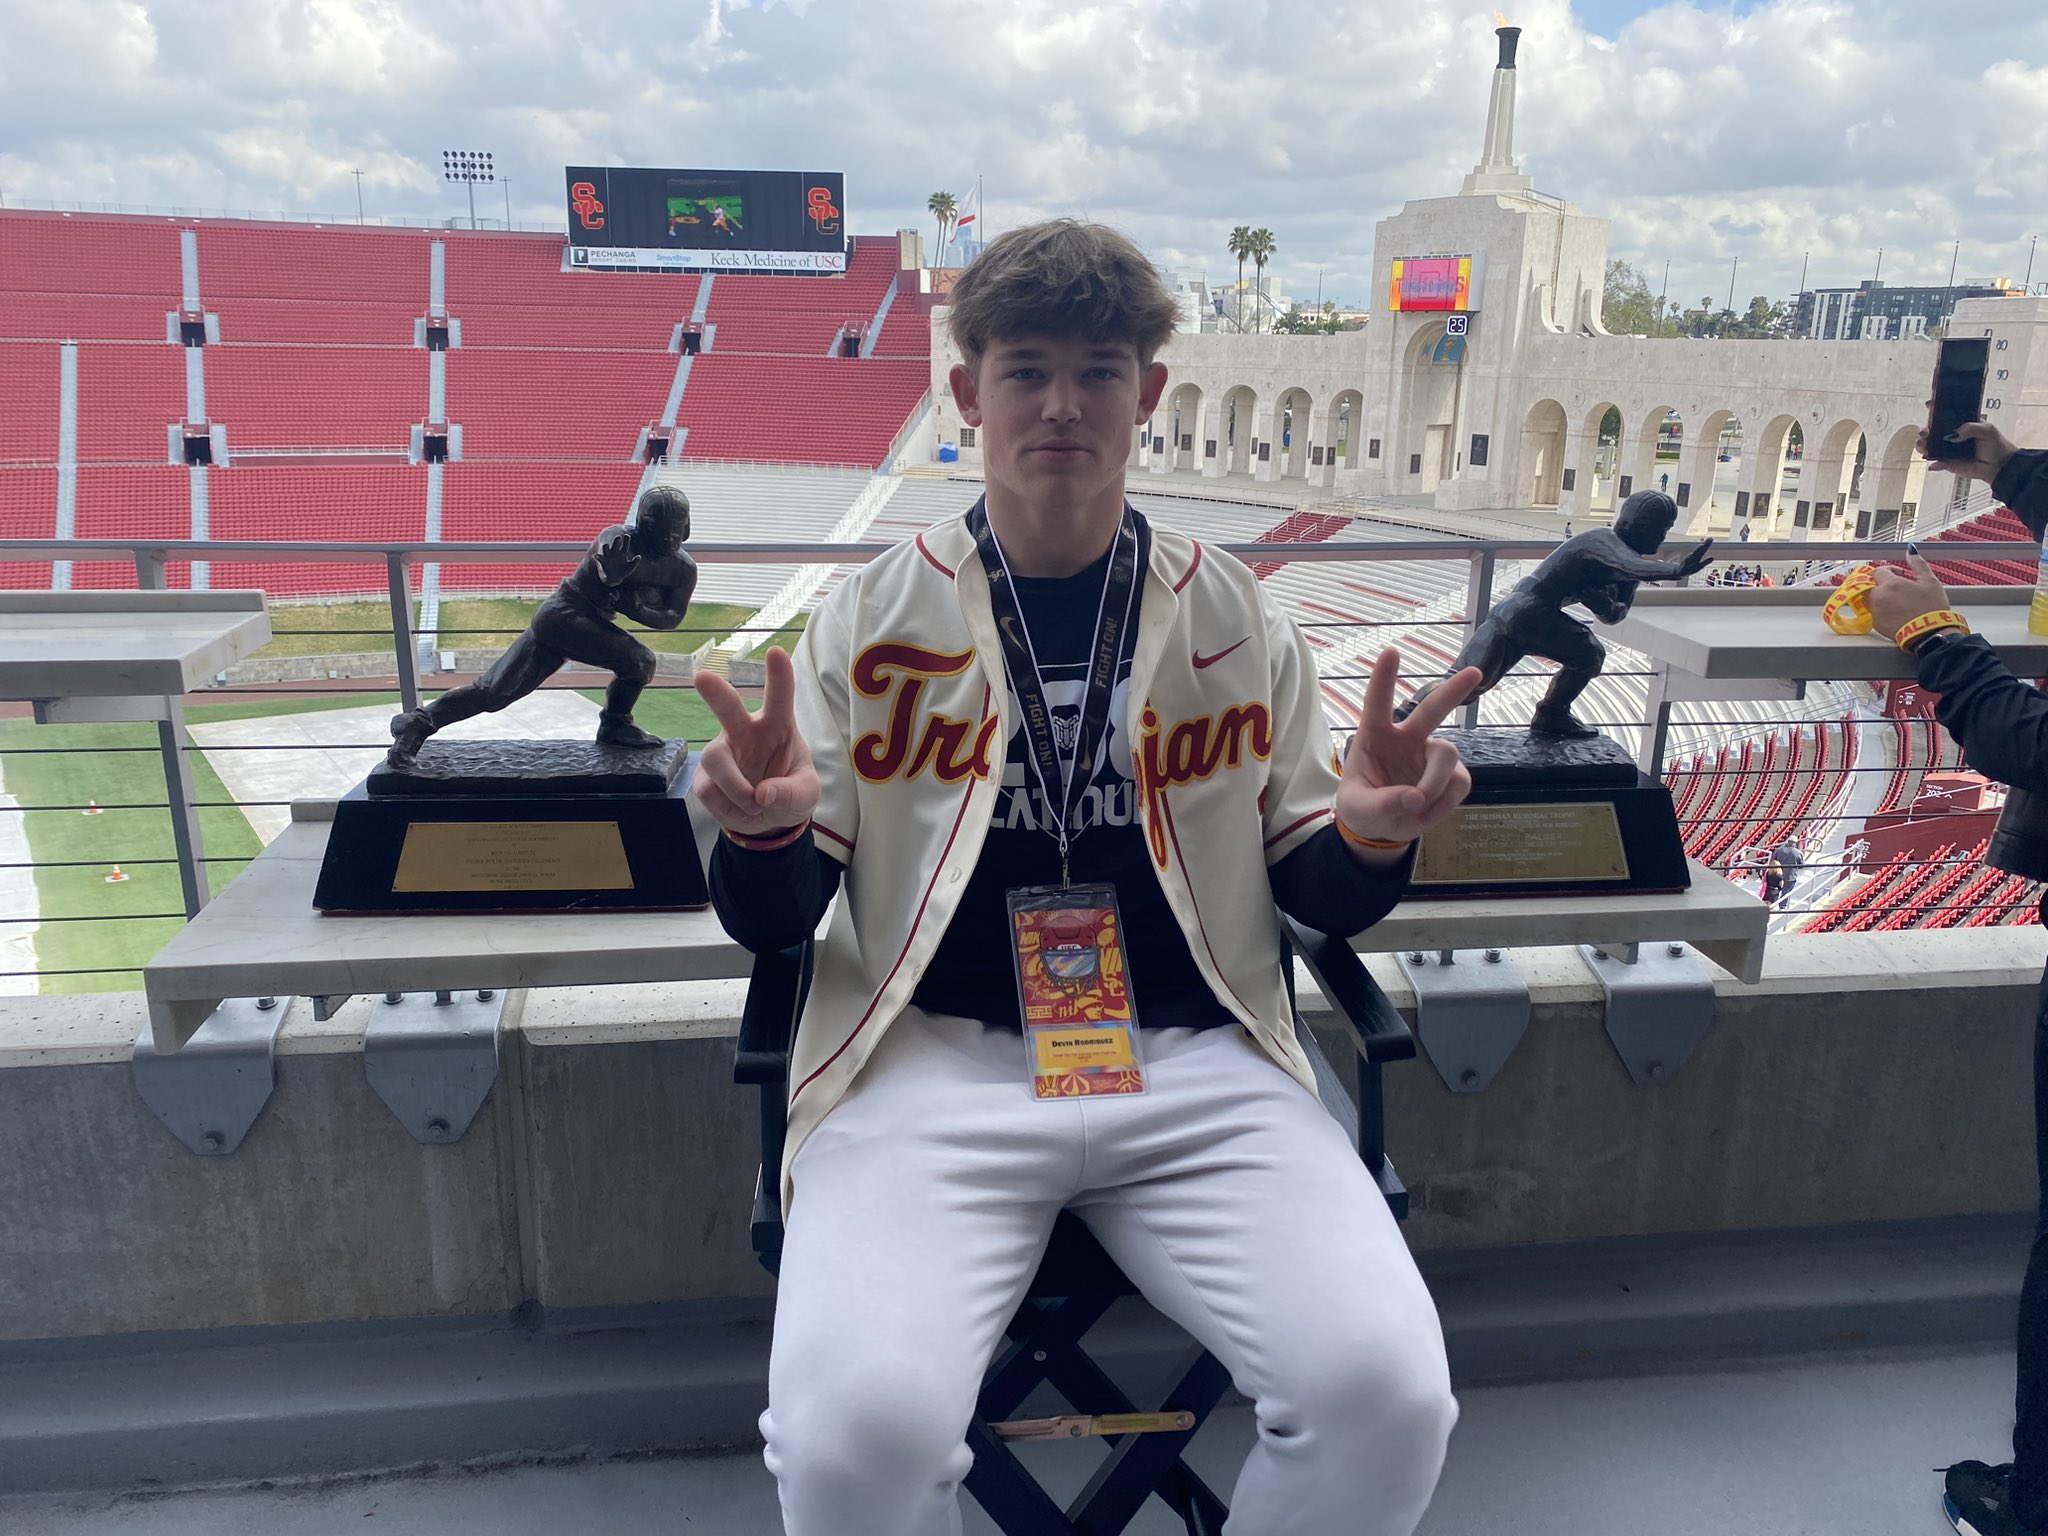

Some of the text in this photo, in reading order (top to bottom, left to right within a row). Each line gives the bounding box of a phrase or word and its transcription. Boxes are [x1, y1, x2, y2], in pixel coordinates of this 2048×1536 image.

[590, 250, 636, 258] PECHANGA
[656, 254, 692, 262] SmartStop
[711, 252, 842, 268] Keck Medicine of USC
[1449, 319, 1464, 332] 25
[1997, 369, 2009, 381] 90
[1986, 398, 2001, 410] 100
[1095, 617, 1118, 689] FIGHT ON!
[1025, 693, 1053, 767] FIGHT ON!
[1052, 1038, 1113, 1048] DEVIN RODRIGUEZ
